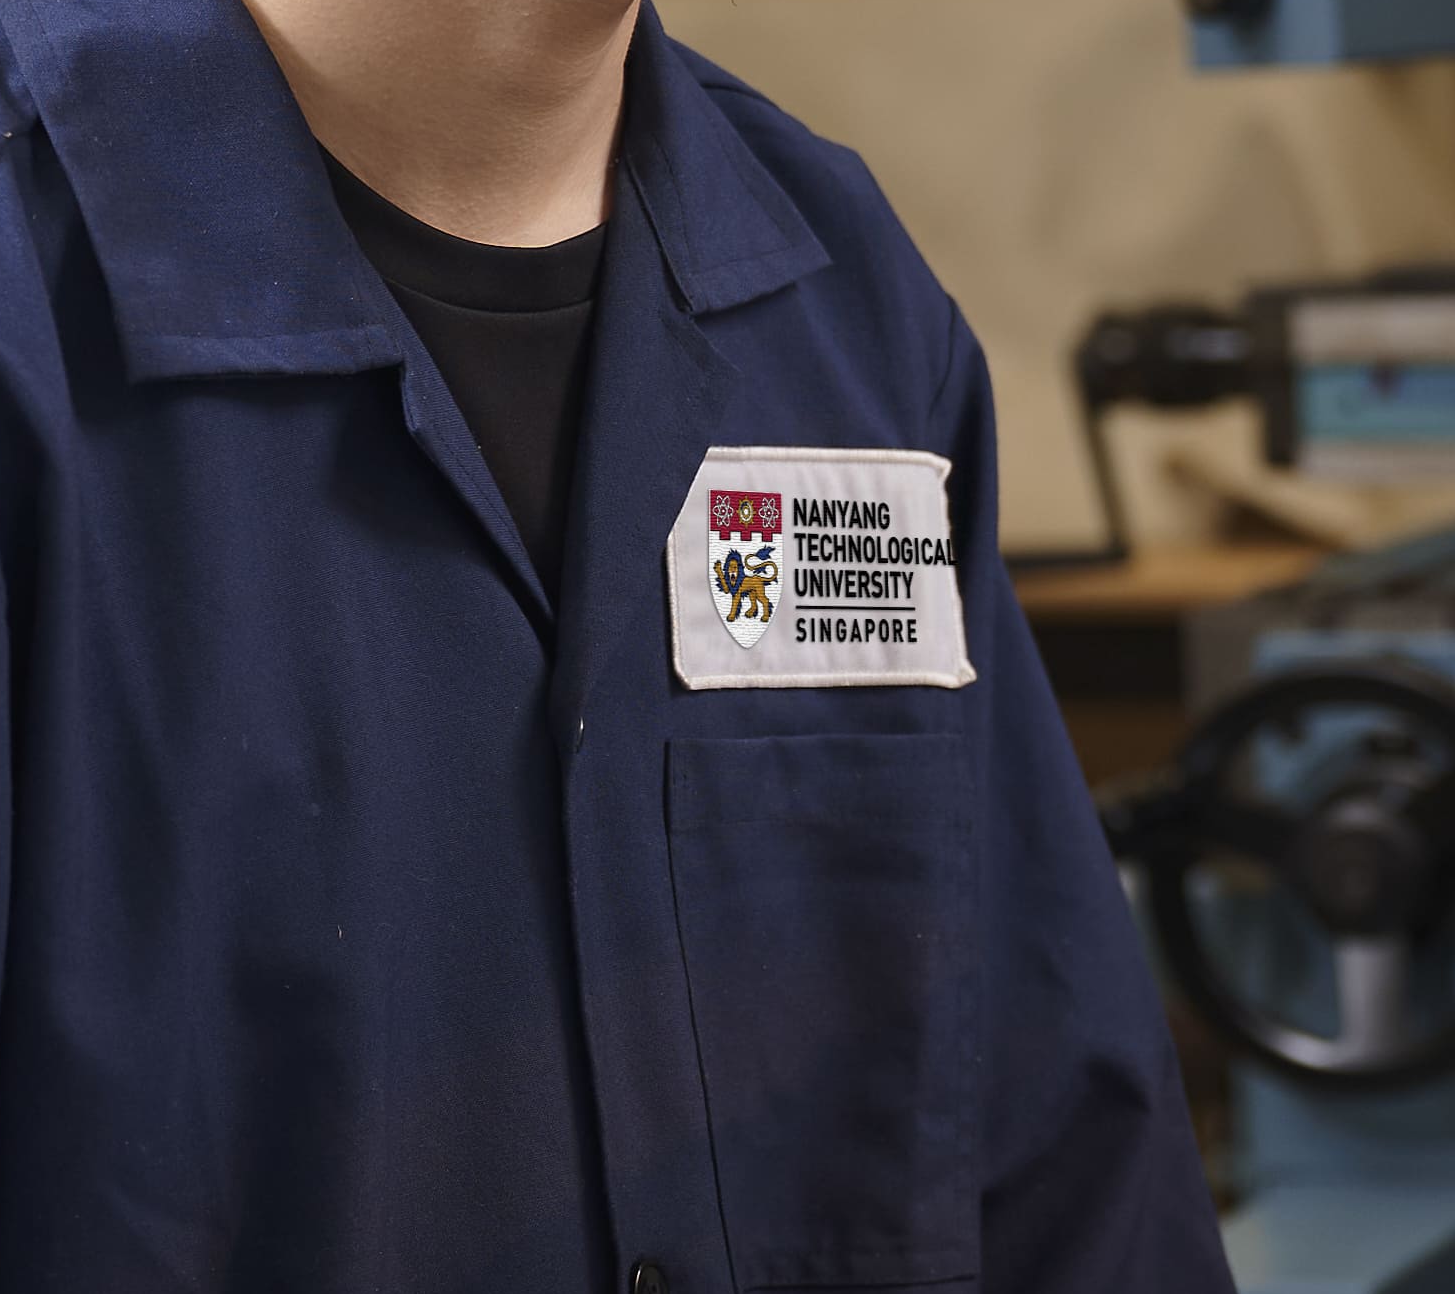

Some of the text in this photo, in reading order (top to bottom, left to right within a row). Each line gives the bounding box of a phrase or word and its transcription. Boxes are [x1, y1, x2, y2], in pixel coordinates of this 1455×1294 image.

[793, 498, 890, 529] NANYANG
[794, 533, 958, 566] TECHNOLOGICAL
[794, 568, 914, 599] UNIVERSITY
[796, 618, 918, 643] SINGAPORE
